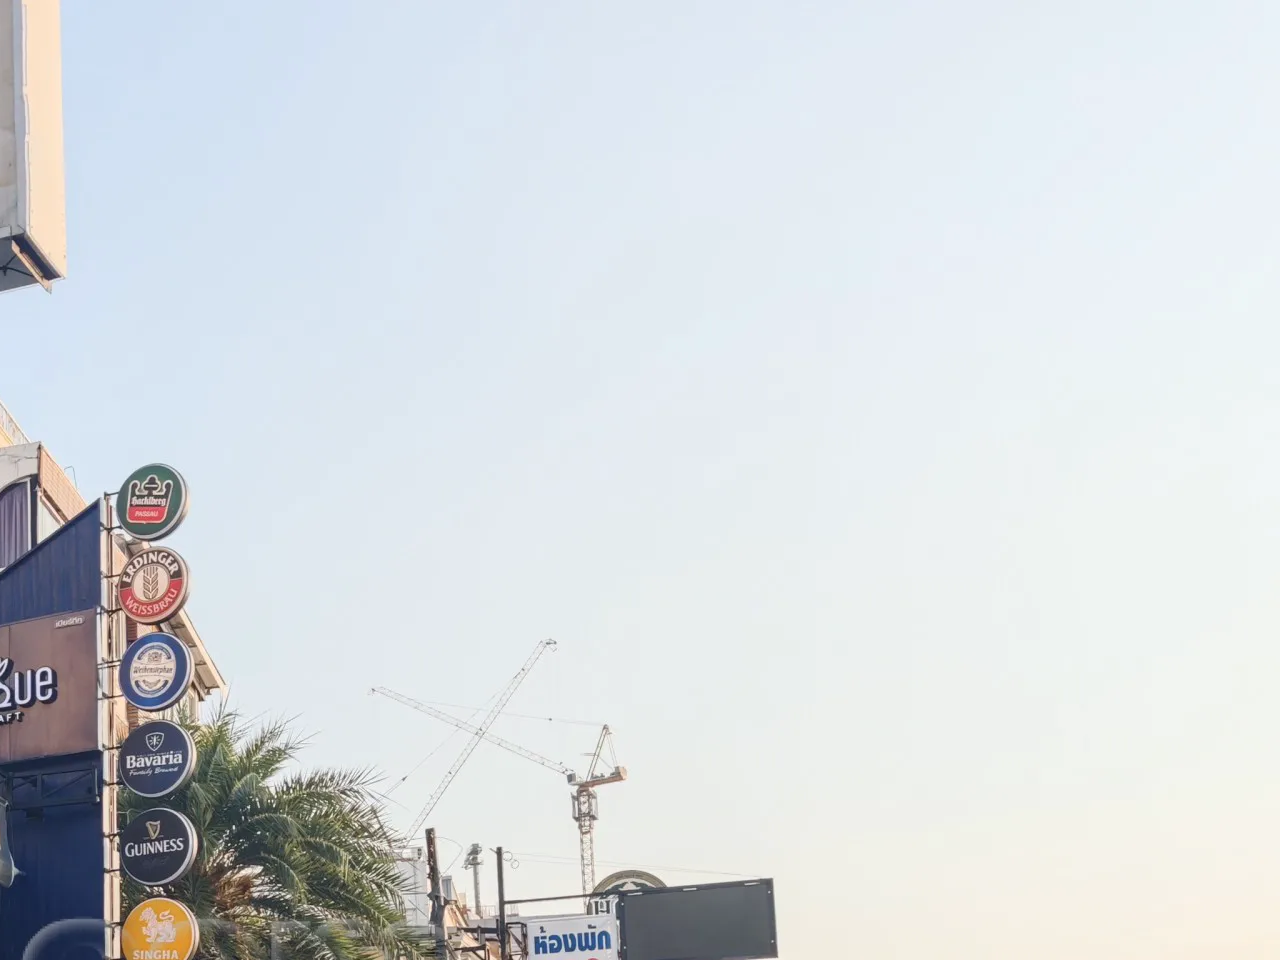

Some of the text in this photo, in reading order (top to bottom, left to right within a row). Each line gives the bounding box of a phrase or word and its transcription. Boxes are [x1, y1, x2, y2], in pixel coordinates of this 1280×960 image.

[134, 510, 159, 518] PASSAU
[122, 551, 179, 584] ERDINGER
[126, 750, 183, 769] Bavaria
[124, 837, 185, 858] GUINNESS
[534, 924, 612, 955] ห้องพัก
[133, 949, 179, 960] SINGHA
